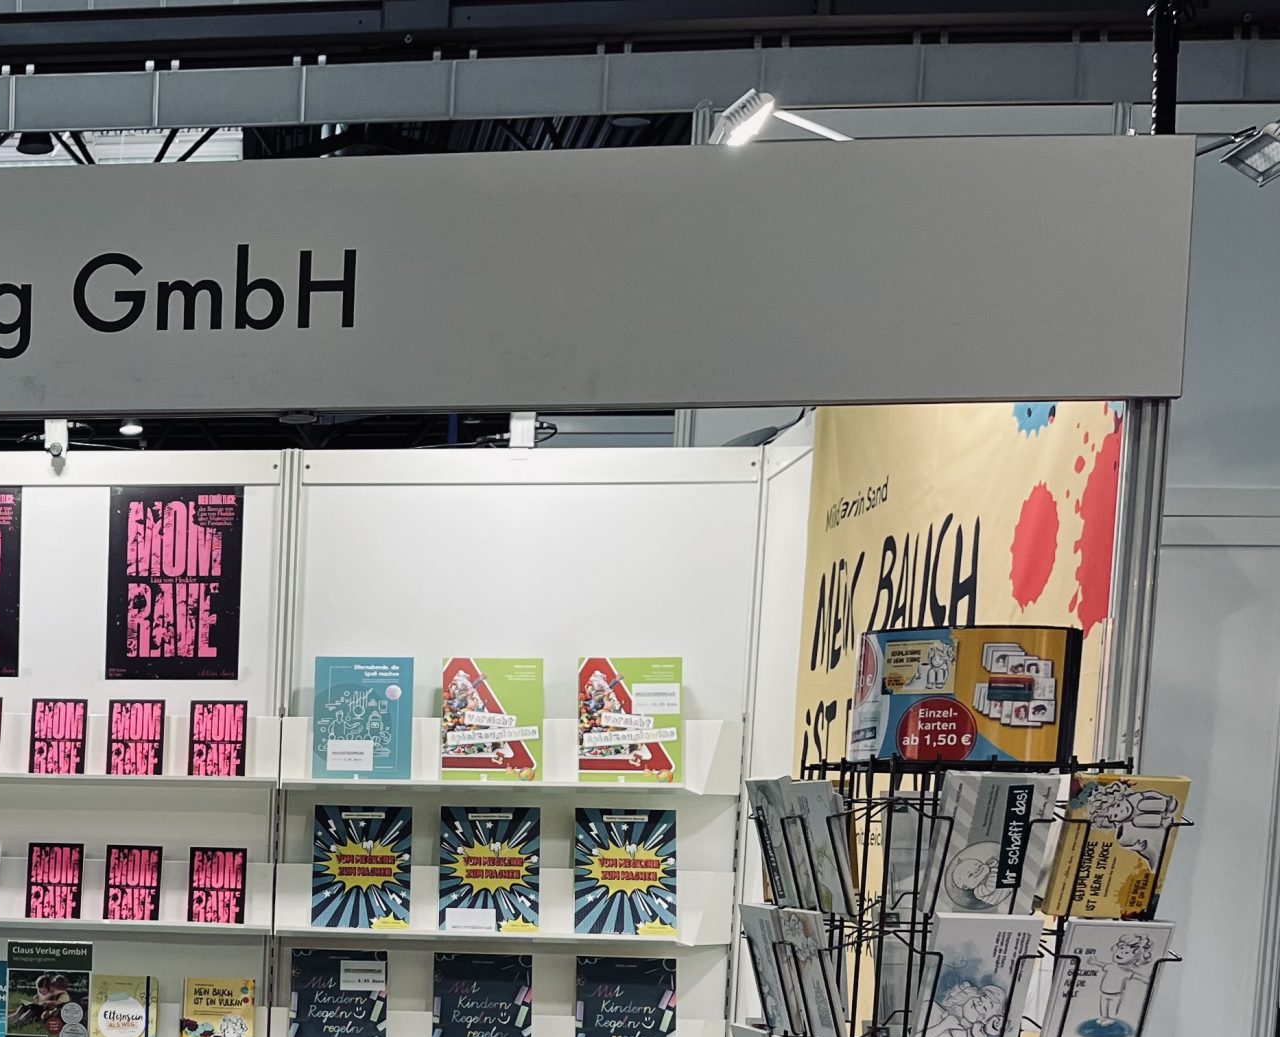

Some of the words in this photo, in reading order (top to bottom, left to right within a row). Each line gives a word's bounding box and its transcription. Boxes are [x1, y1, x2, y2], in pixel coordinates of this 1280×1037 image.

[72, 244, 358, 333] GmbH
[126, 500, 223, 577] MOM
[126, 582, 219, 658] RAVE
[35, 702, 84, 739] MOM
[918, 707, 958, 718] Einzel-
[111, 703, 161, 741] MOM
[192, 704, 245, 741] MOM
[918, 719, 957, 730] karten
[902, 734, 919, 746] ab
[923, 734, 957, 747] 1,50
[960, 733, 972, 746] €
[34, 740, 81, 774] RAVE
[109, 742, 160, 775] RAVE
[192, 743, 242, 776] RAVE
[1004, 821, 1025, 869] schafft
[1015, 788, 1029, 818] das!
[31, 846, 80, 884] MOM
[109, 848, 159, 886] MOM
[336, 854, 355, 864] VOM
[463, 856, 482, 867] VOM
[598, 857, 620, 869] VOM
[193, 849, 244, 889] MOM
[338, 867, 356, 876] ZUM
[465, 869, 484, 879] ZUM
[600, 871, 620, 881] ZUM
[12, 946, 34, 955] Claus
[35, 947, 61, 957] Verlag
[62, 947, 88, 956] GmbH
[305, 975, 337, 989] Mit
[448, 980, 480, 995] Mit
[313, 990, 368, 1005] Kindern
[590, 984, 624, 998] Mit
[457, 995, 512, 1010] Kindern
[600, 999, 657, 1015] Kindern
[103, 1010, 144, 1022] Elternsein
[307, 1004, 352, 1024] Regeln
[451, 1010, 496, 1028] Regeln
[322, 1020, 364, 1037] regeln
[595, 1014, 640, 1032] Regeln
